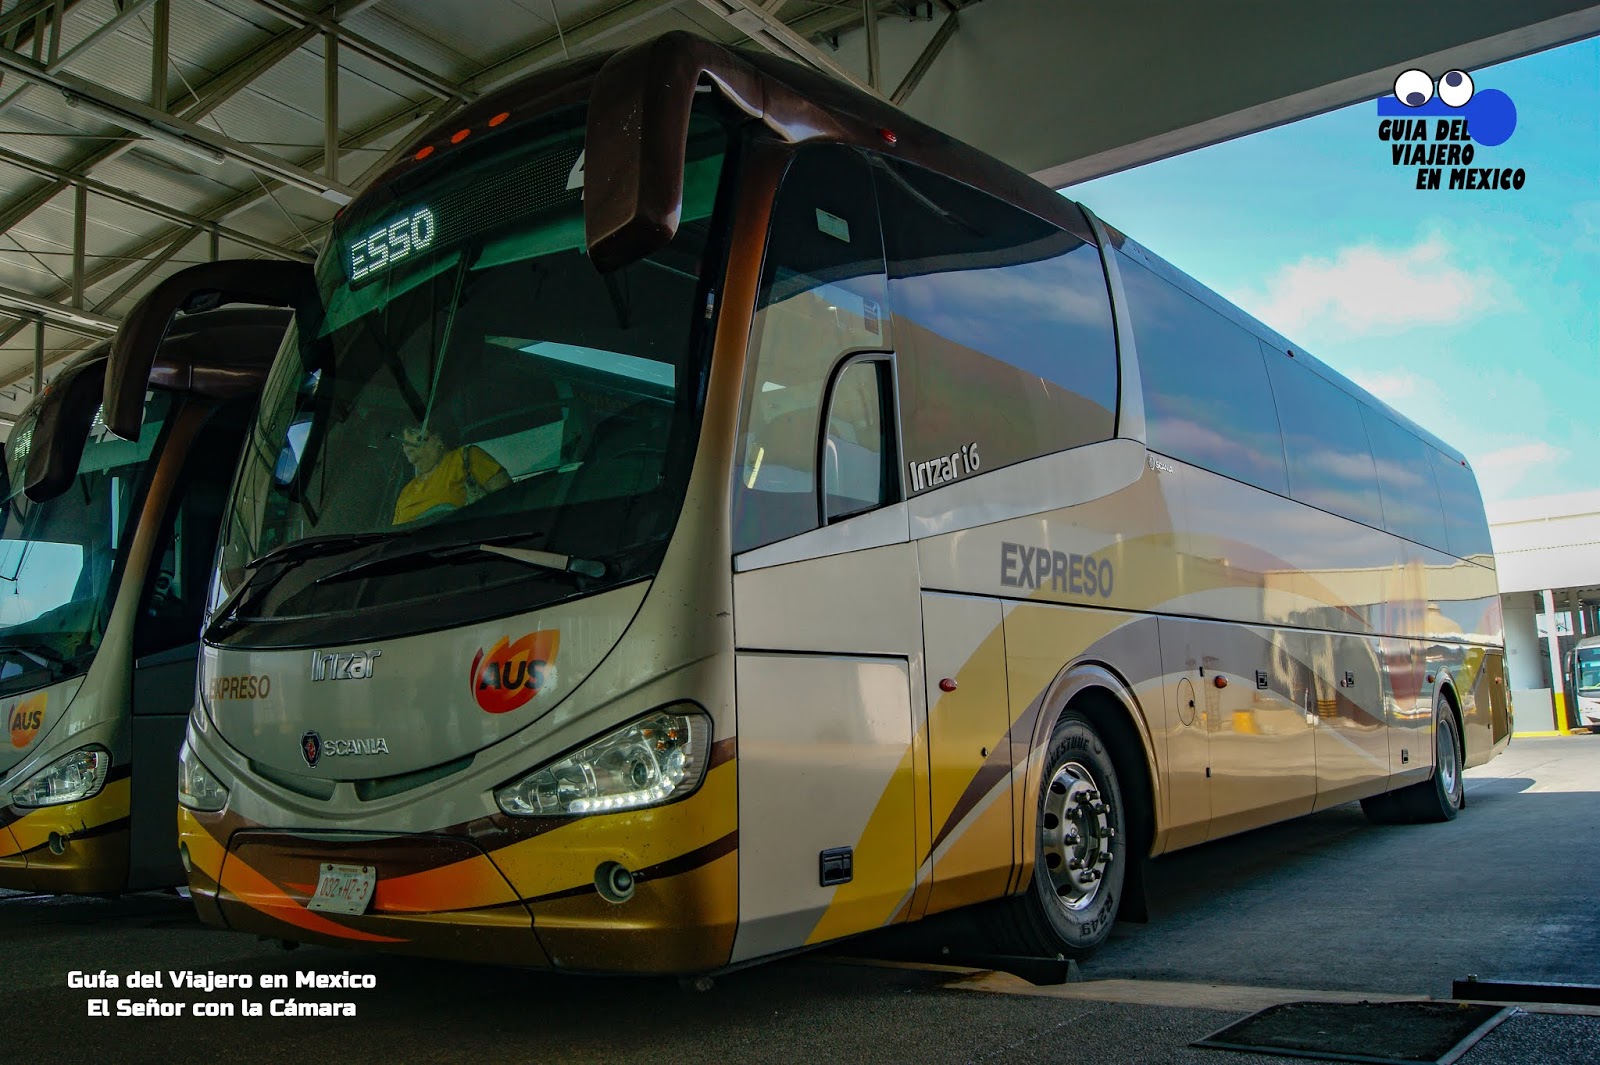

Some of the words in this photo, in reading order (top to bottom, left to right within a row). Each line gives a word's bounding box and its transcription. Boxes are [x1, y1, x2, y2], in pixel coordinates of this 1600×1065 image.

[909, 452, 960, 492] Irizar
[960, 442, 980, 474] i6
[1001, 541, 1113, 598] EXPRESO
[312, 650, 381, 681] Irizar
[479, 660, 547, 690] AUS
[209, 675, 271, 700] EXPRESO
[12, 711, 42, 730] AUS
[324, 738, 389, 757] SCANIA
